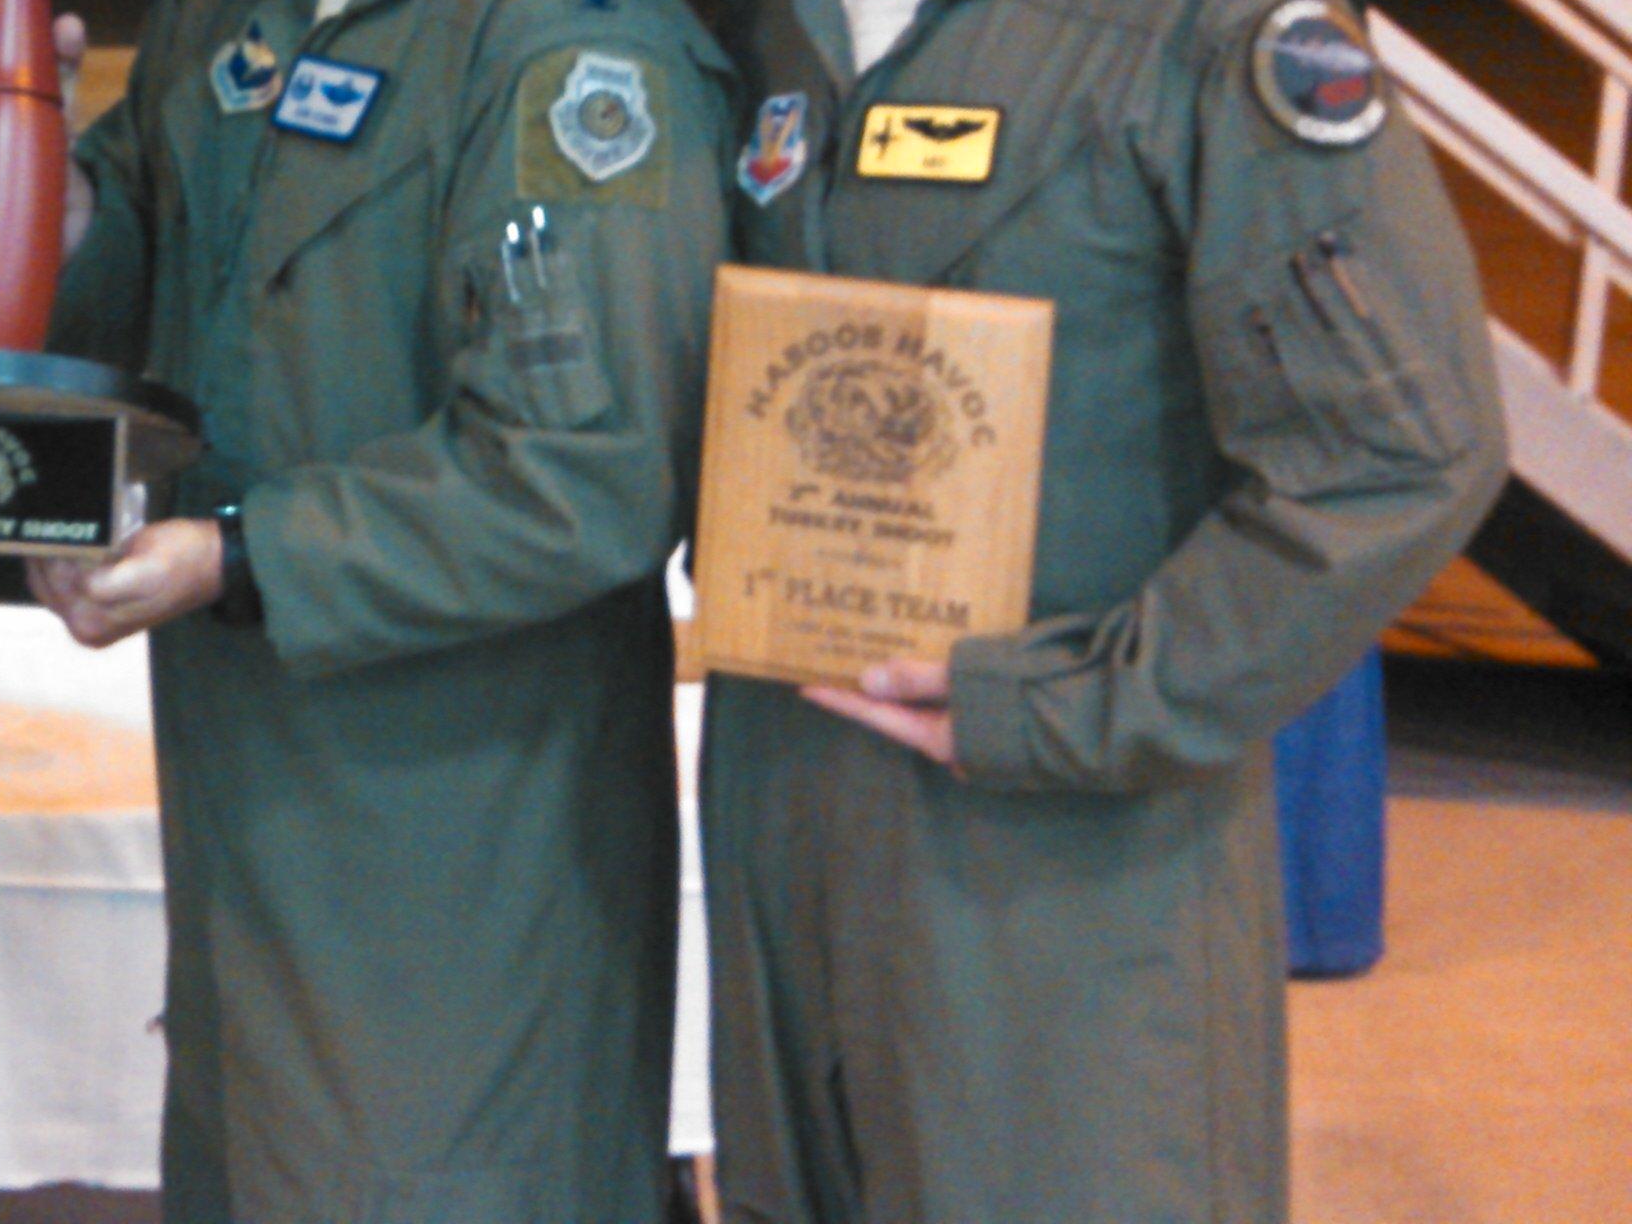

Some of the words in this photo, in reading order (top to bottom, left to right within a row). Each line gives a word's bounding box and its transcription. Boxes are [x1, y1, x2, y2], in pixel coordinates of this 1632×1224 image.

[745, 322, 885, 422] HABOOB
[897, 330, 997, 450] HAVOC
[22, 519, 100, 542] SHOOT
[771, 506, 864, 536] TURKEY
[786, 576, 879, 615] PLACE
[887, 591, 971, 625] TEAM
